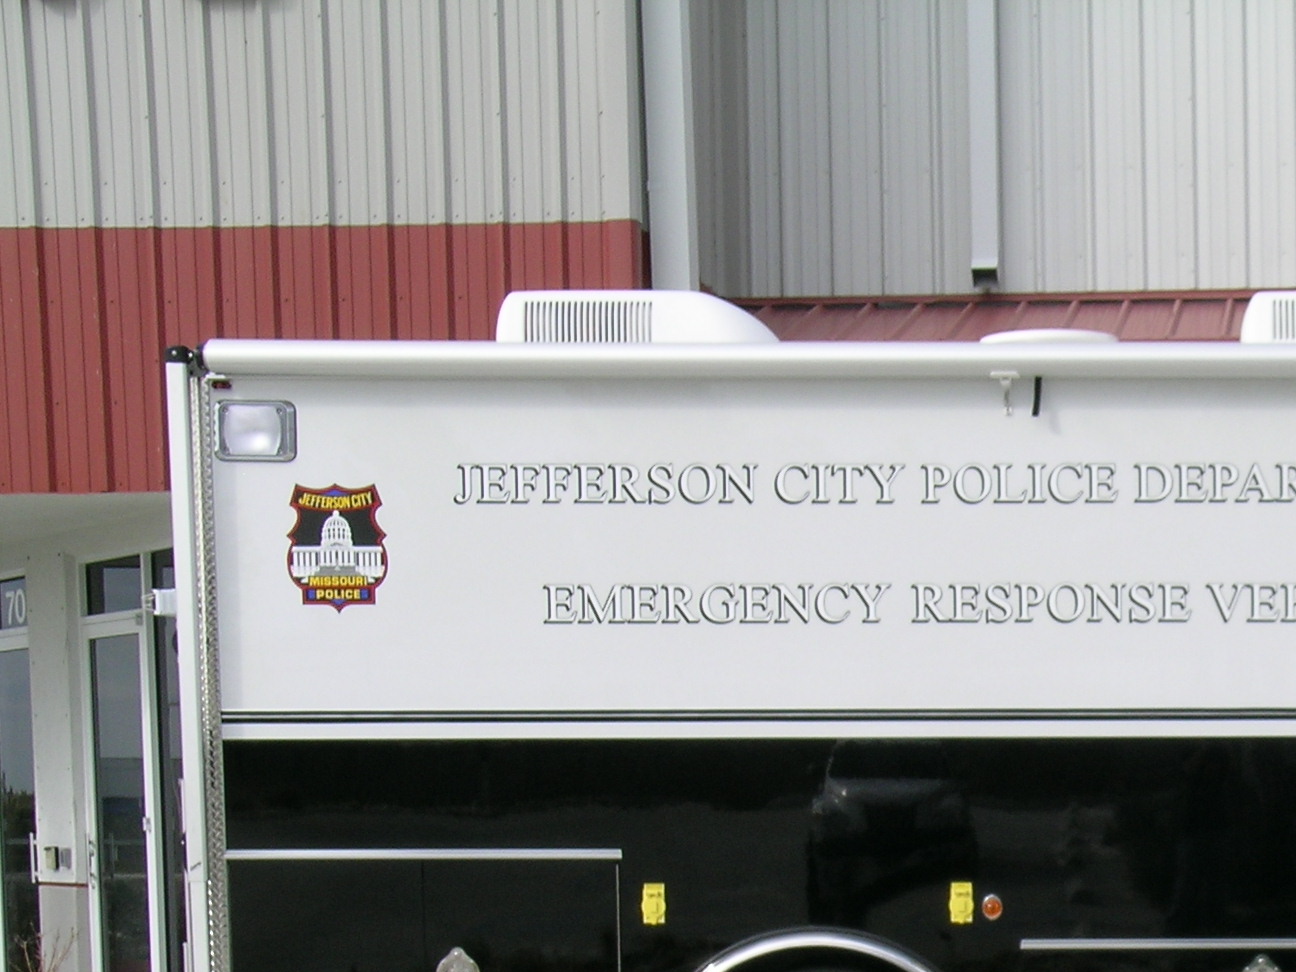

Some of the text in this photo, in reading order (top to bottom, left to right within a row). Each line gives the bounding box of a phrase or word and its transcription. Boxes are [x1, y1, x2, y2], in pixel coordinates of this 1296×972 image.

[454, 463, 759, 505] JEFFERSON
[773, 463, 905, 504] CITY
[920, 463, 1117, 504] POLICE
[298, 491, 372, 510] JEFFERSON CITY
[308, 576, 367, 586] MISSOURI
[316, 588, 361, 600] POLICE
[5, 588, 26, 625] 70
[542, 583, 892, 624] EMERGENCY
[910, 583, 1191, 624] RESPONSE
